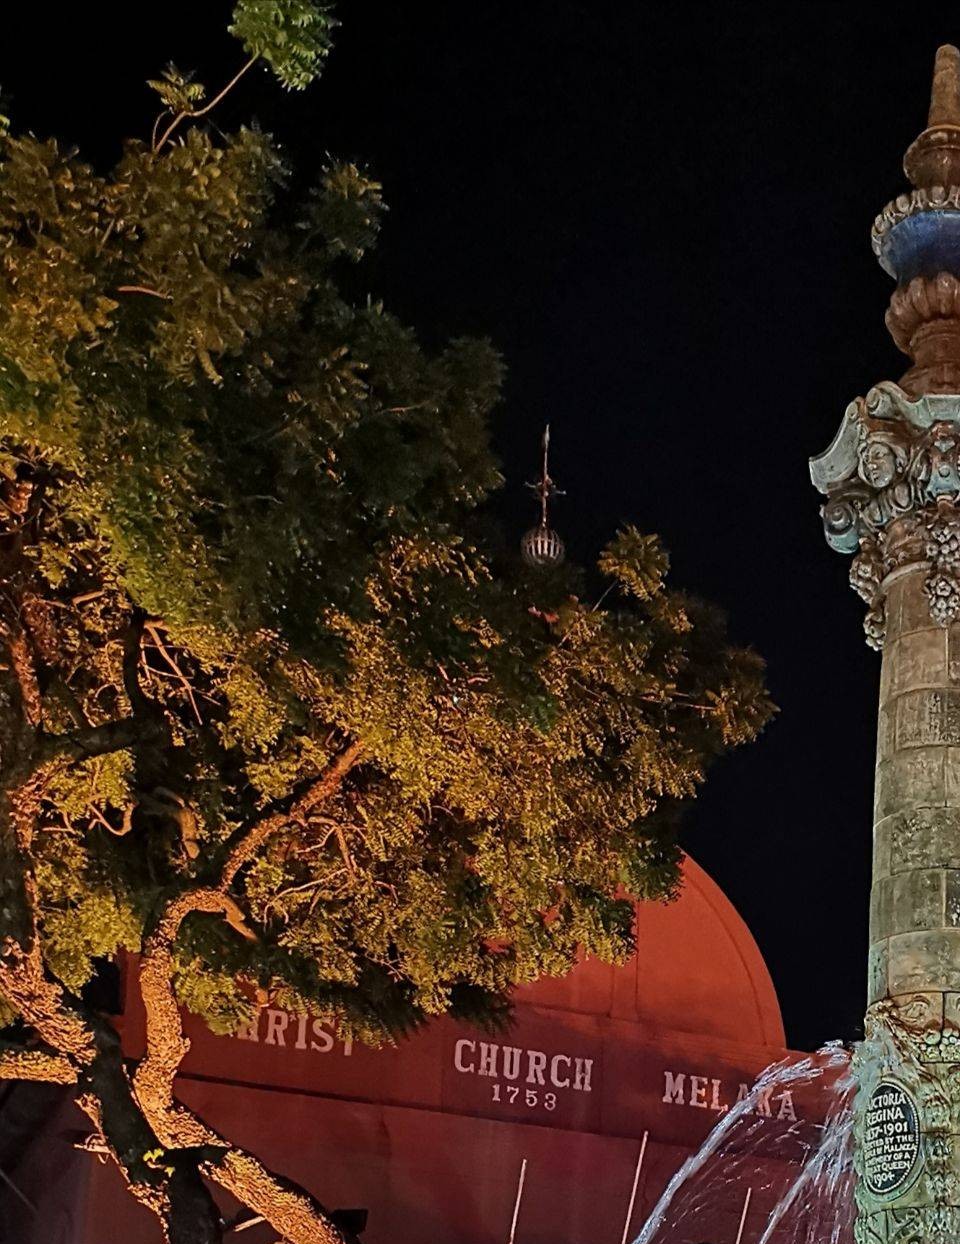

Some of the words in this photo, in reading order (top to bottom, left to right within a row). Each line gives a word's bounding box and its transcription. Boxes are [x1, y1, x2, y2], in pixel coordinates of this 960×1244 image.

[236, 1008, 353, 1056] HRIS
[454, 1039, 594, 1092] CHURCH
[491, 1084, 557, 1111] 1753
[895, 1134, 915, 1143] THE
[893, 1152, 903, 1161] OF
[904, 1151, 911, 1160] A
